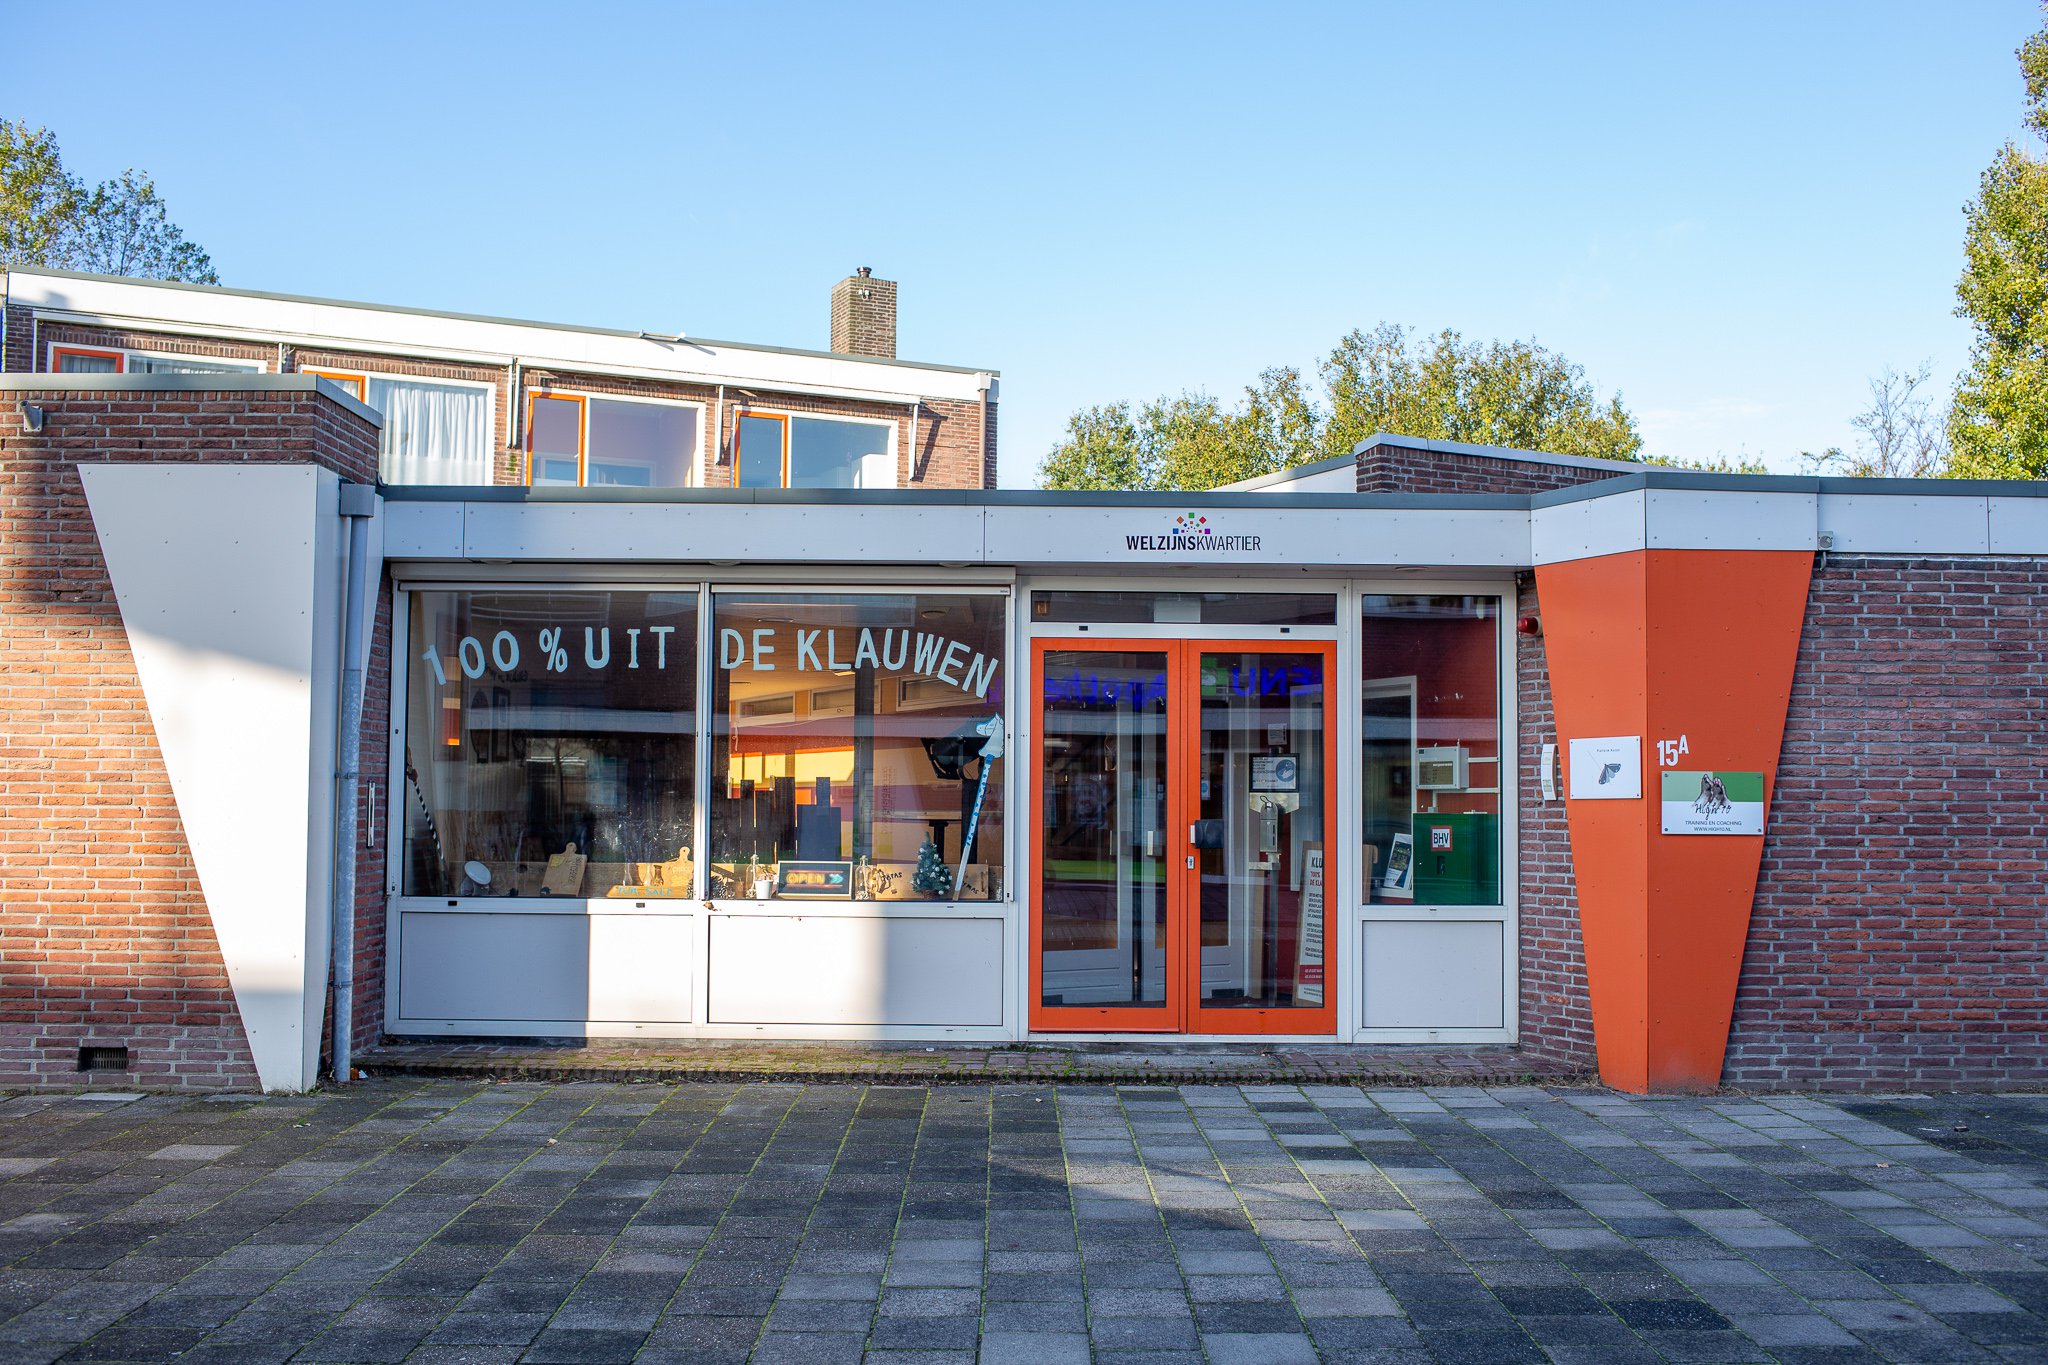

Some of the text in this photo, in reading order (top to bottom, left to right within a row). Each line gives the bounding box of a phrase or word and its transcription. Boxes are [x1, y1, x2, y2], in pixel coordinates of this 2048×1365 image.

[1126, 535, 1261, 551] WELZIJNSKWARTIER
[584, 626, 675, 669] UIT
[720, 628, 775, 671] DE
[797, 627, 999, 699] KLAUWEN
[1433, 832, 1449, 844] BHV
[786, 873, 825, 885] OPEN
[645, 886, 673, 897] SALE
